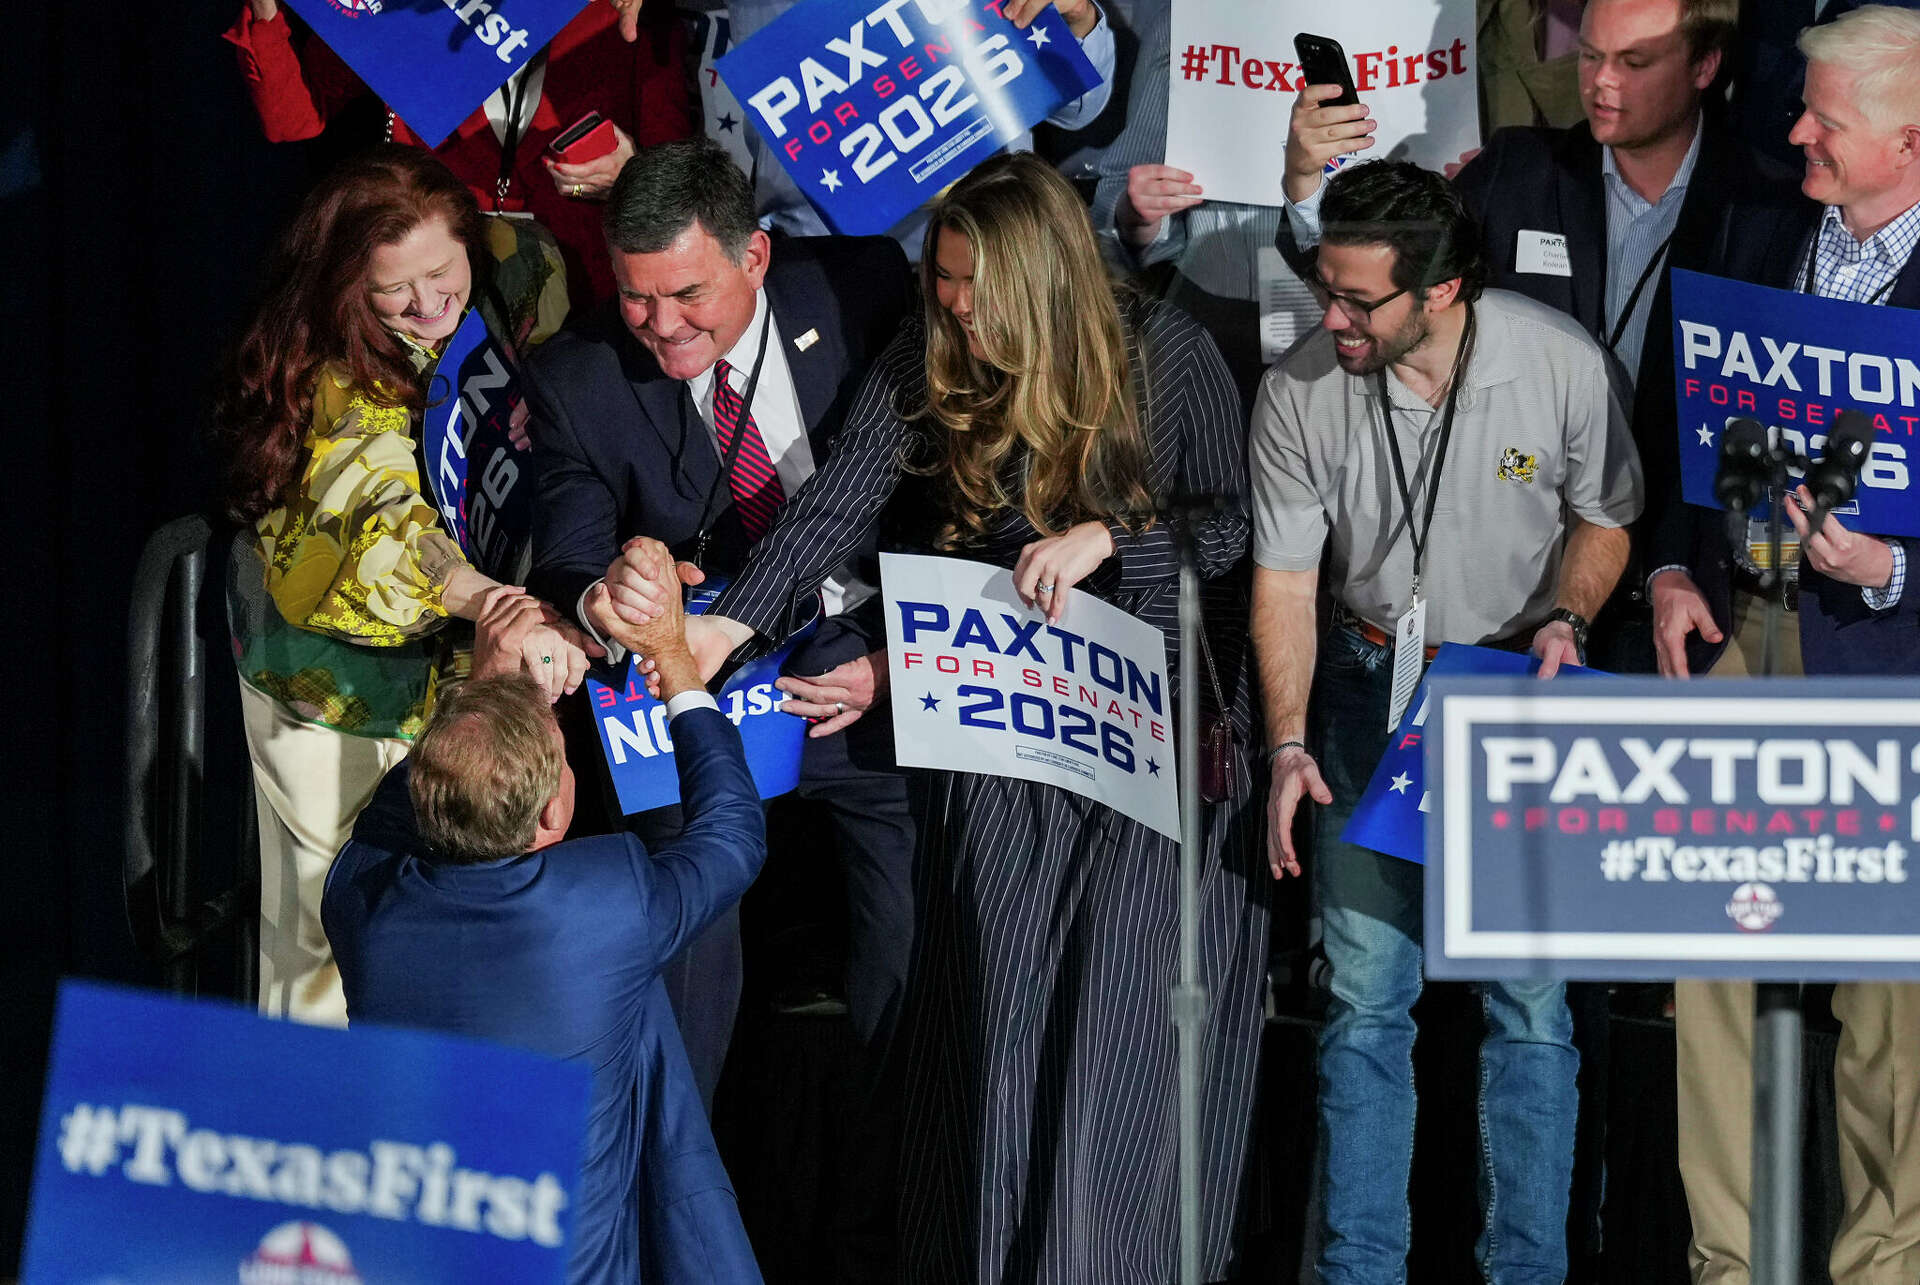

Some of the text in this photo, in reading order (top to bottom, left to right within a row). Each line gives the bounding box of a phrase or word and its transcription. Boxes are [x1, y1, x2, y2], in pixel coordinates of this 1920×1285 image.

[1181, 38, 1467, 92] #TexFirst
[784, 101, 859, 162] FOR
[840, 33, 1024, 184] 2026
[1685, 379, 1920, 436] FOR SEAT
[896, 600, 1163, 716] PAXTON
[904, 652, 1165, 742] FOR SENATE
[957, 684, 1136, 774] 2026
[1482, 738, 1900, 805] PAXTON
[1525, 808, 1863, 835] FOR SENATE
[1600, 836, 1908, 884] #TexasFirst
[58, 1103, 567, 1248] #TexasFirst
